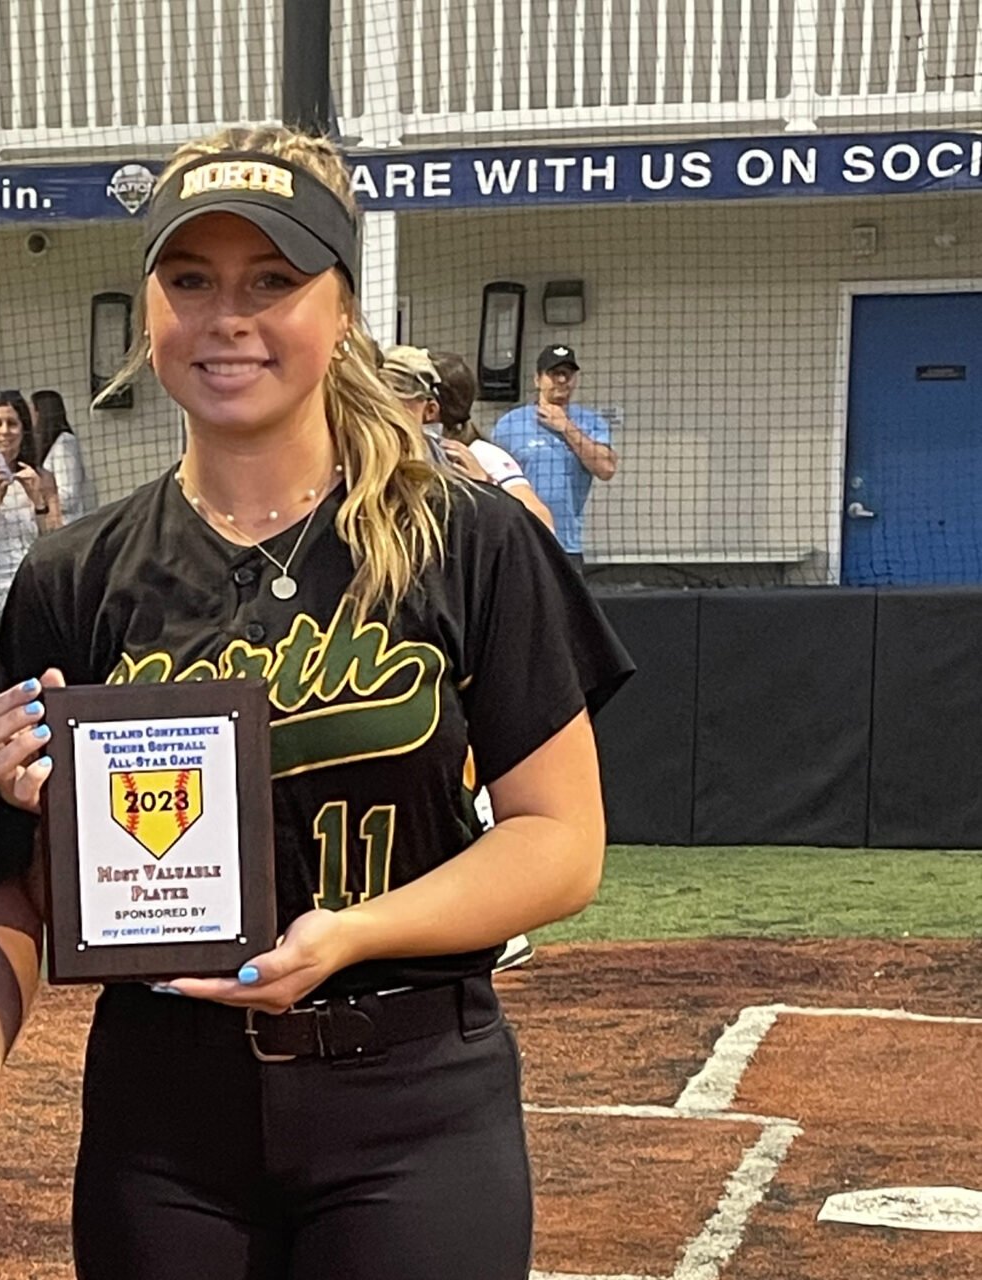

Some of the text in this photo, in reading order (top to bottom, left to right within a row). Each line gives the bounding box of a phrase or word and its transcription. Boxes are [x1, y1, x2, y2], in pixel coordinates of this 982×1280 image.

[180, 161, 294, 199] NORTH
[350, 141, 982, 199] ARE WITH US ON SOCI
[105, 594, 445, 715] rth
[124, 790, 190, 813] 2023
[313, 800, 397, 912] 11
[115, 907, 206, 920] SPONSORED BY
